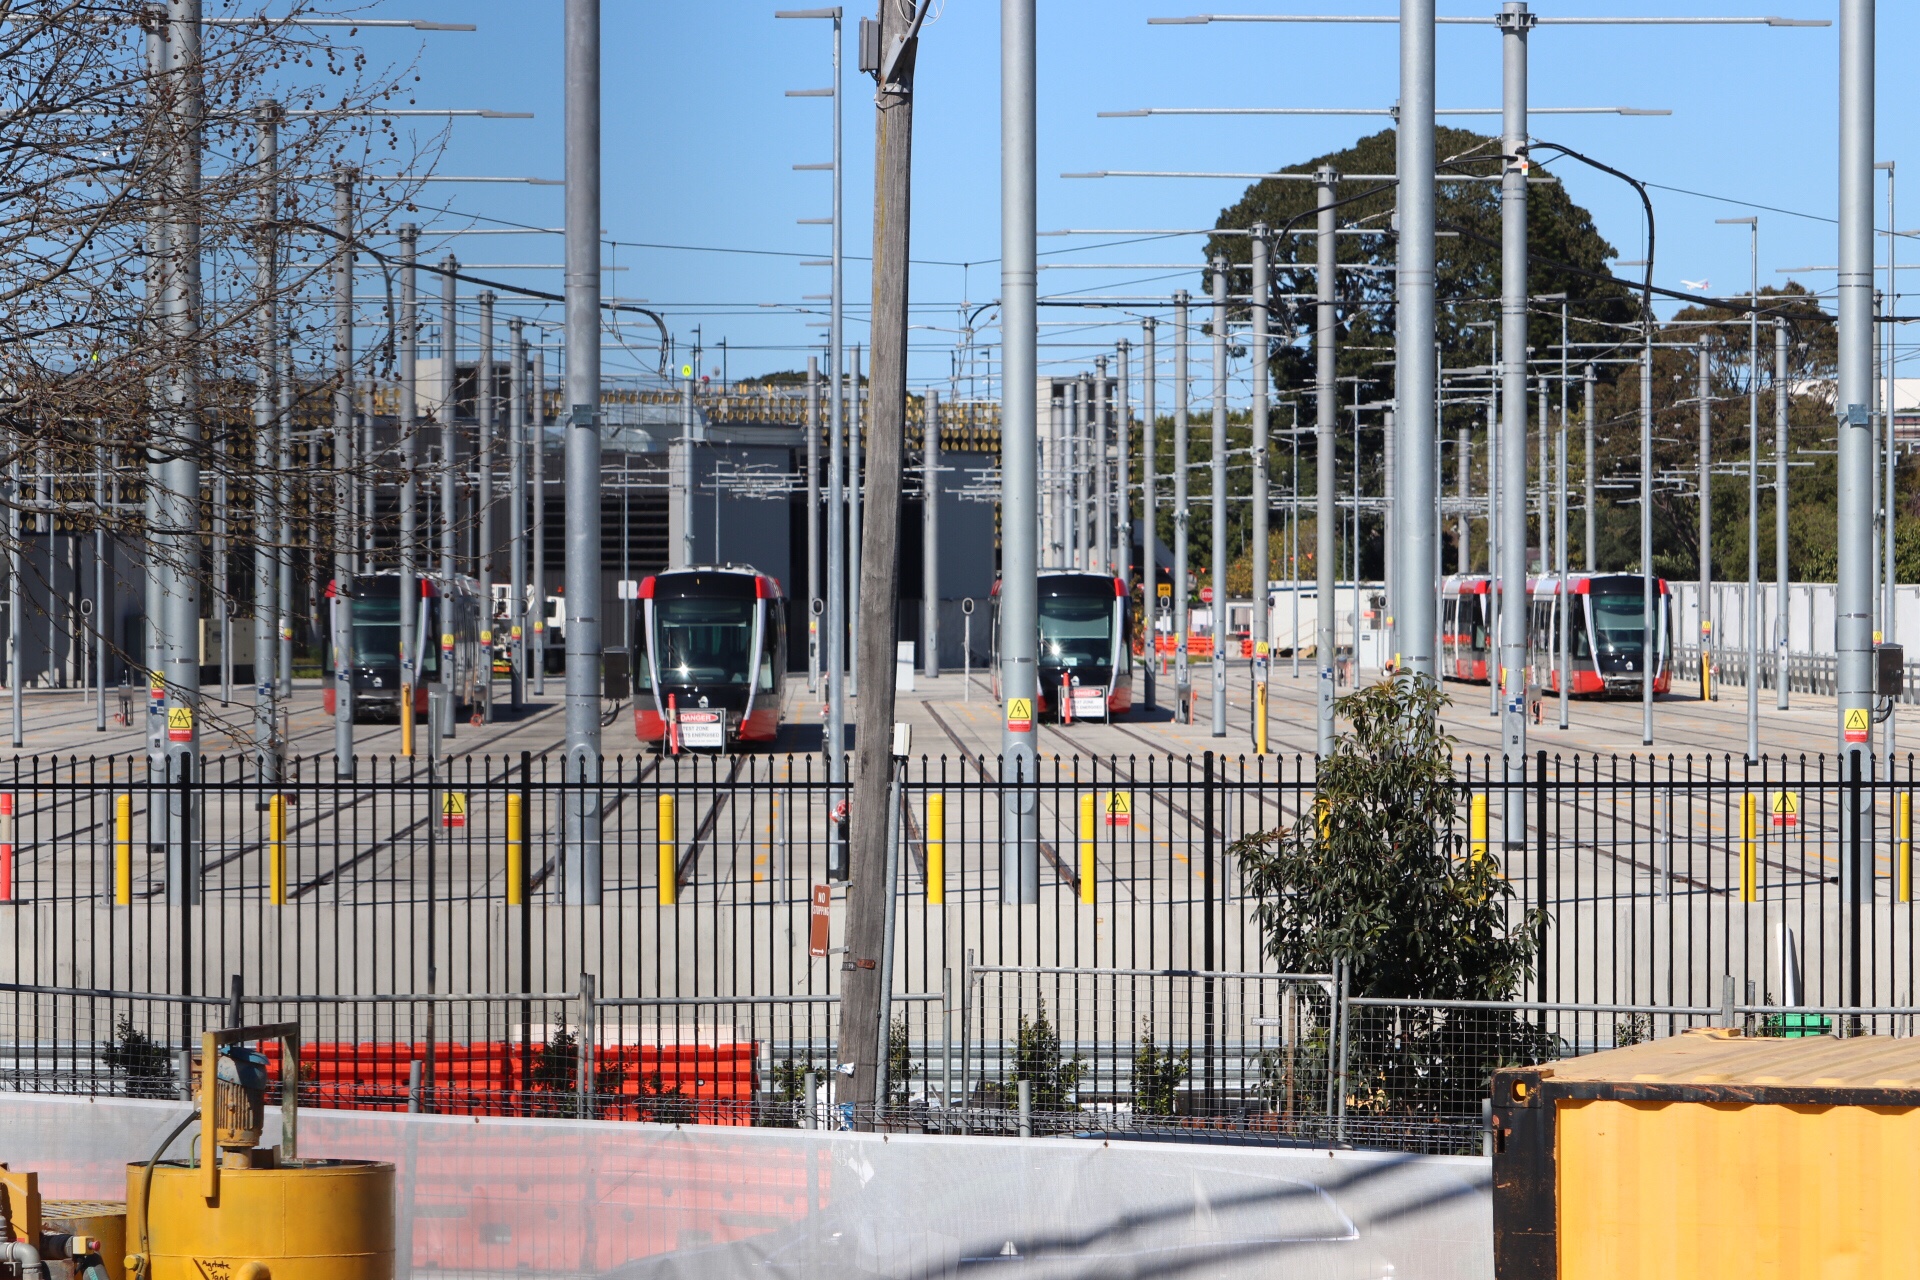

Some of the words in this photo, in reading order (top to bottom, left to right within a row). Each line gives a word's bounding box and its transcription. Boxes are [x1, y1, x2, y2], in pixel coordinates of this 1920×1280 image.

[680, 713, 711, 722] DANGER
[818, 892, 826, 904] NO
[813, 905, 830, 916] STOPPING
